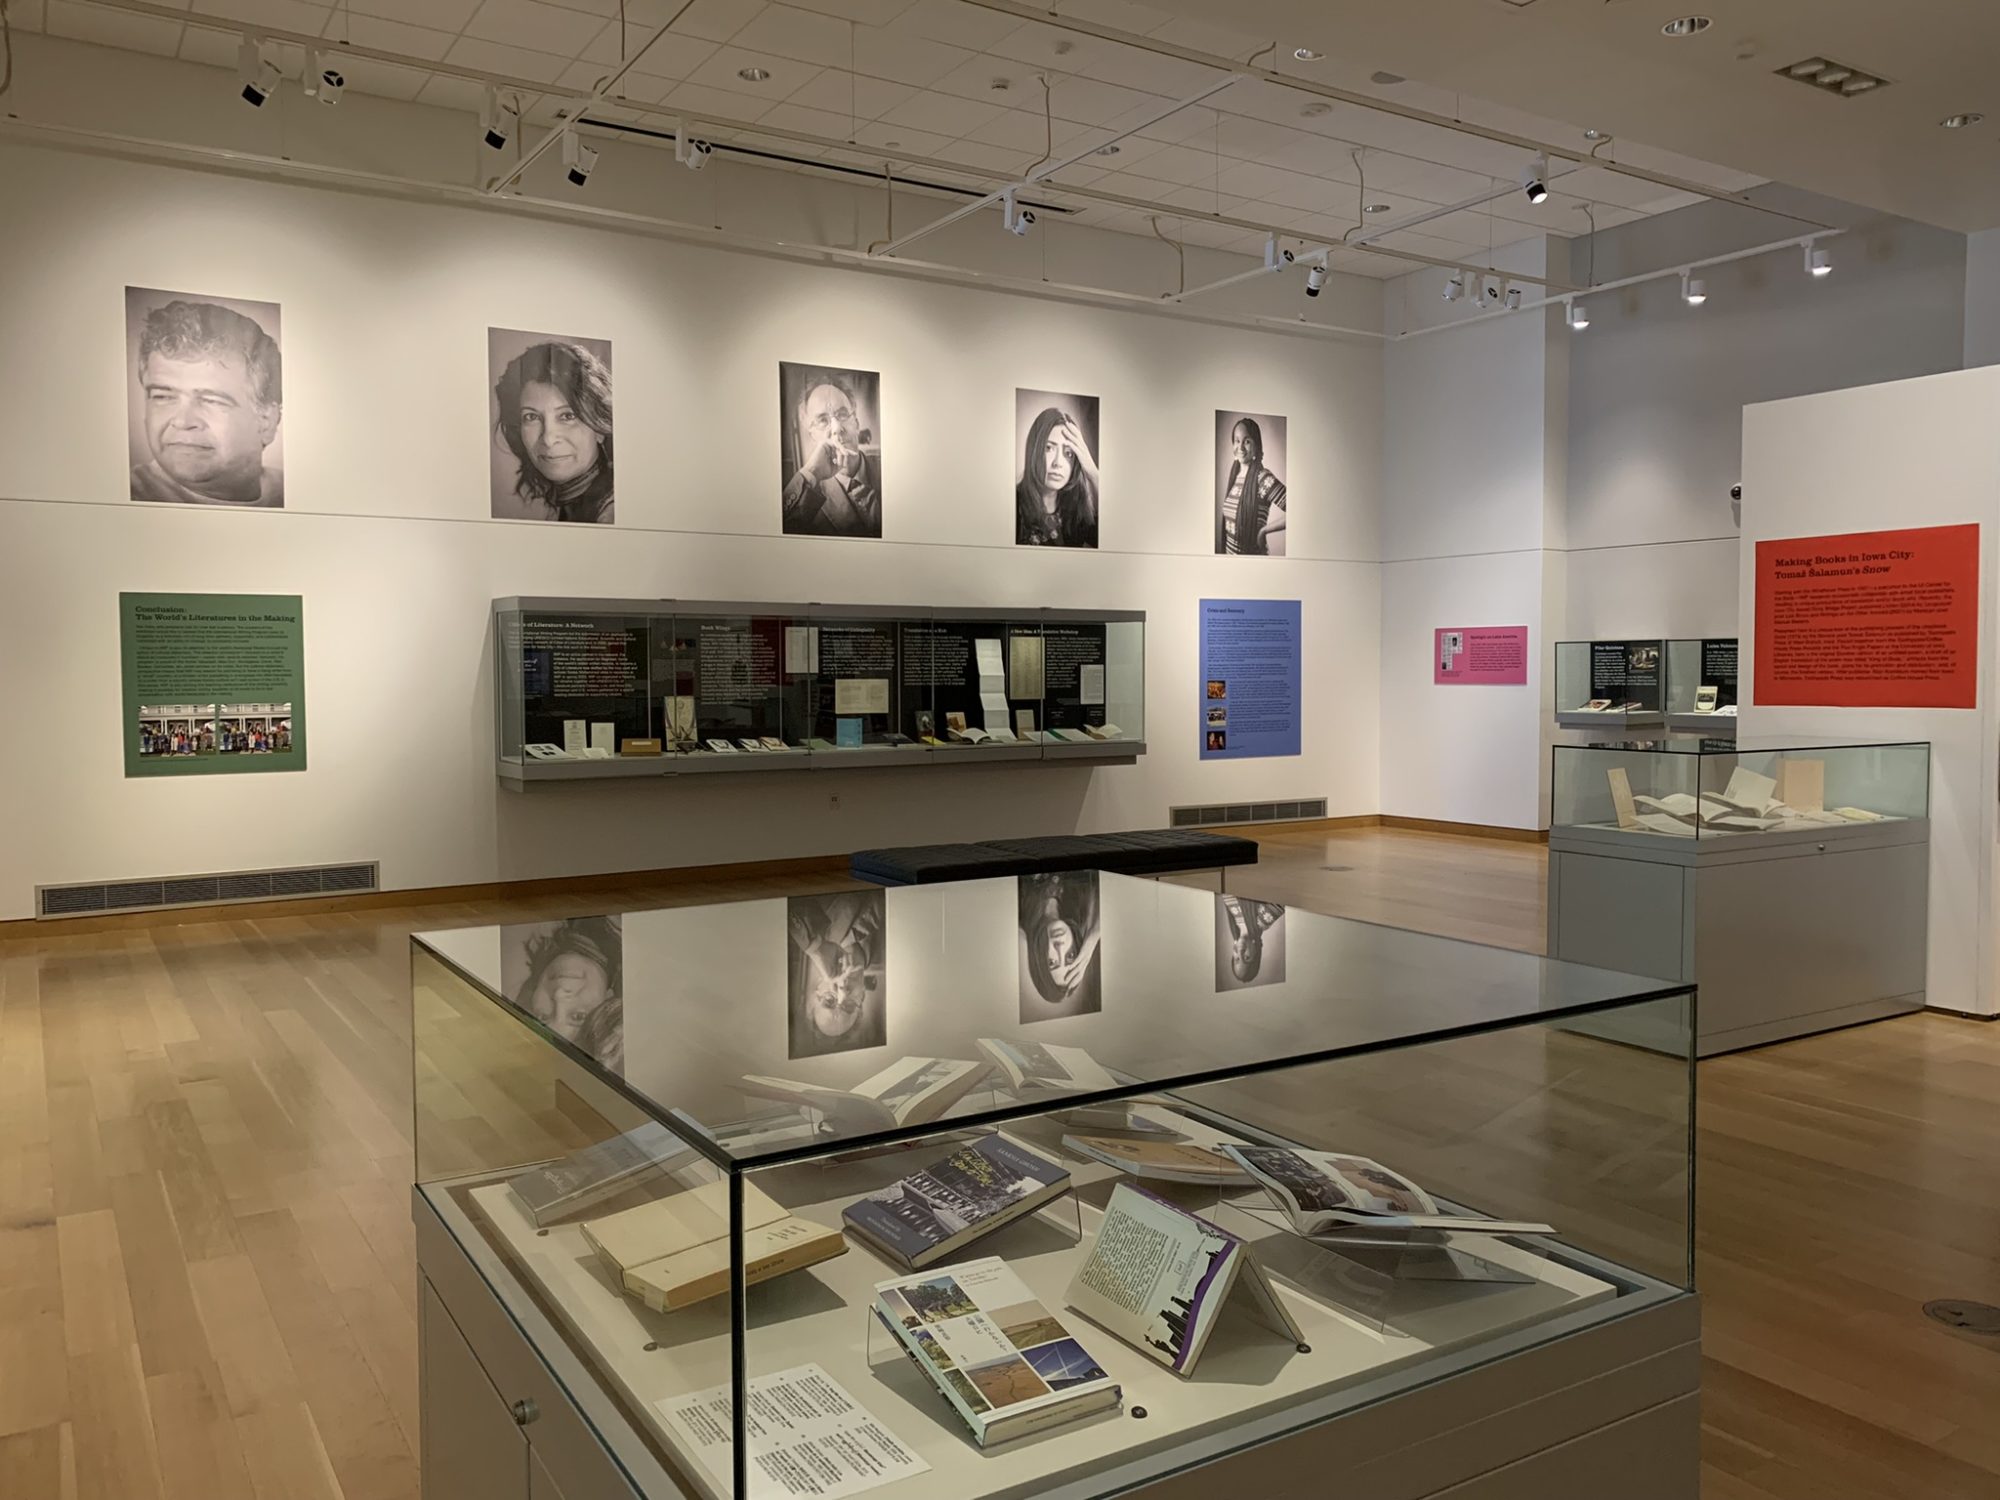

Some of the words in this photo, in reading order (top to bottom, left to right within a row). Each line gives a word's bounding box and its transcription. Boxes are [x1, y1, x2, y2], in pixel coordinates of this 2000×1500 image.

[1775, 557, 1812, 568] Making
[1815, 556, 1846, 565] Books
[1849, 554, 1859, 562] in
[1861, 553, 1886, 562] Iowa
[1888, 551, 1914, 561] City:
[1861, 565, 1892, 575] Snow
[188, 614, 237, 622] Literatures
[249, 614, 261, 622] the
[263, 615, 296, 623] Making
